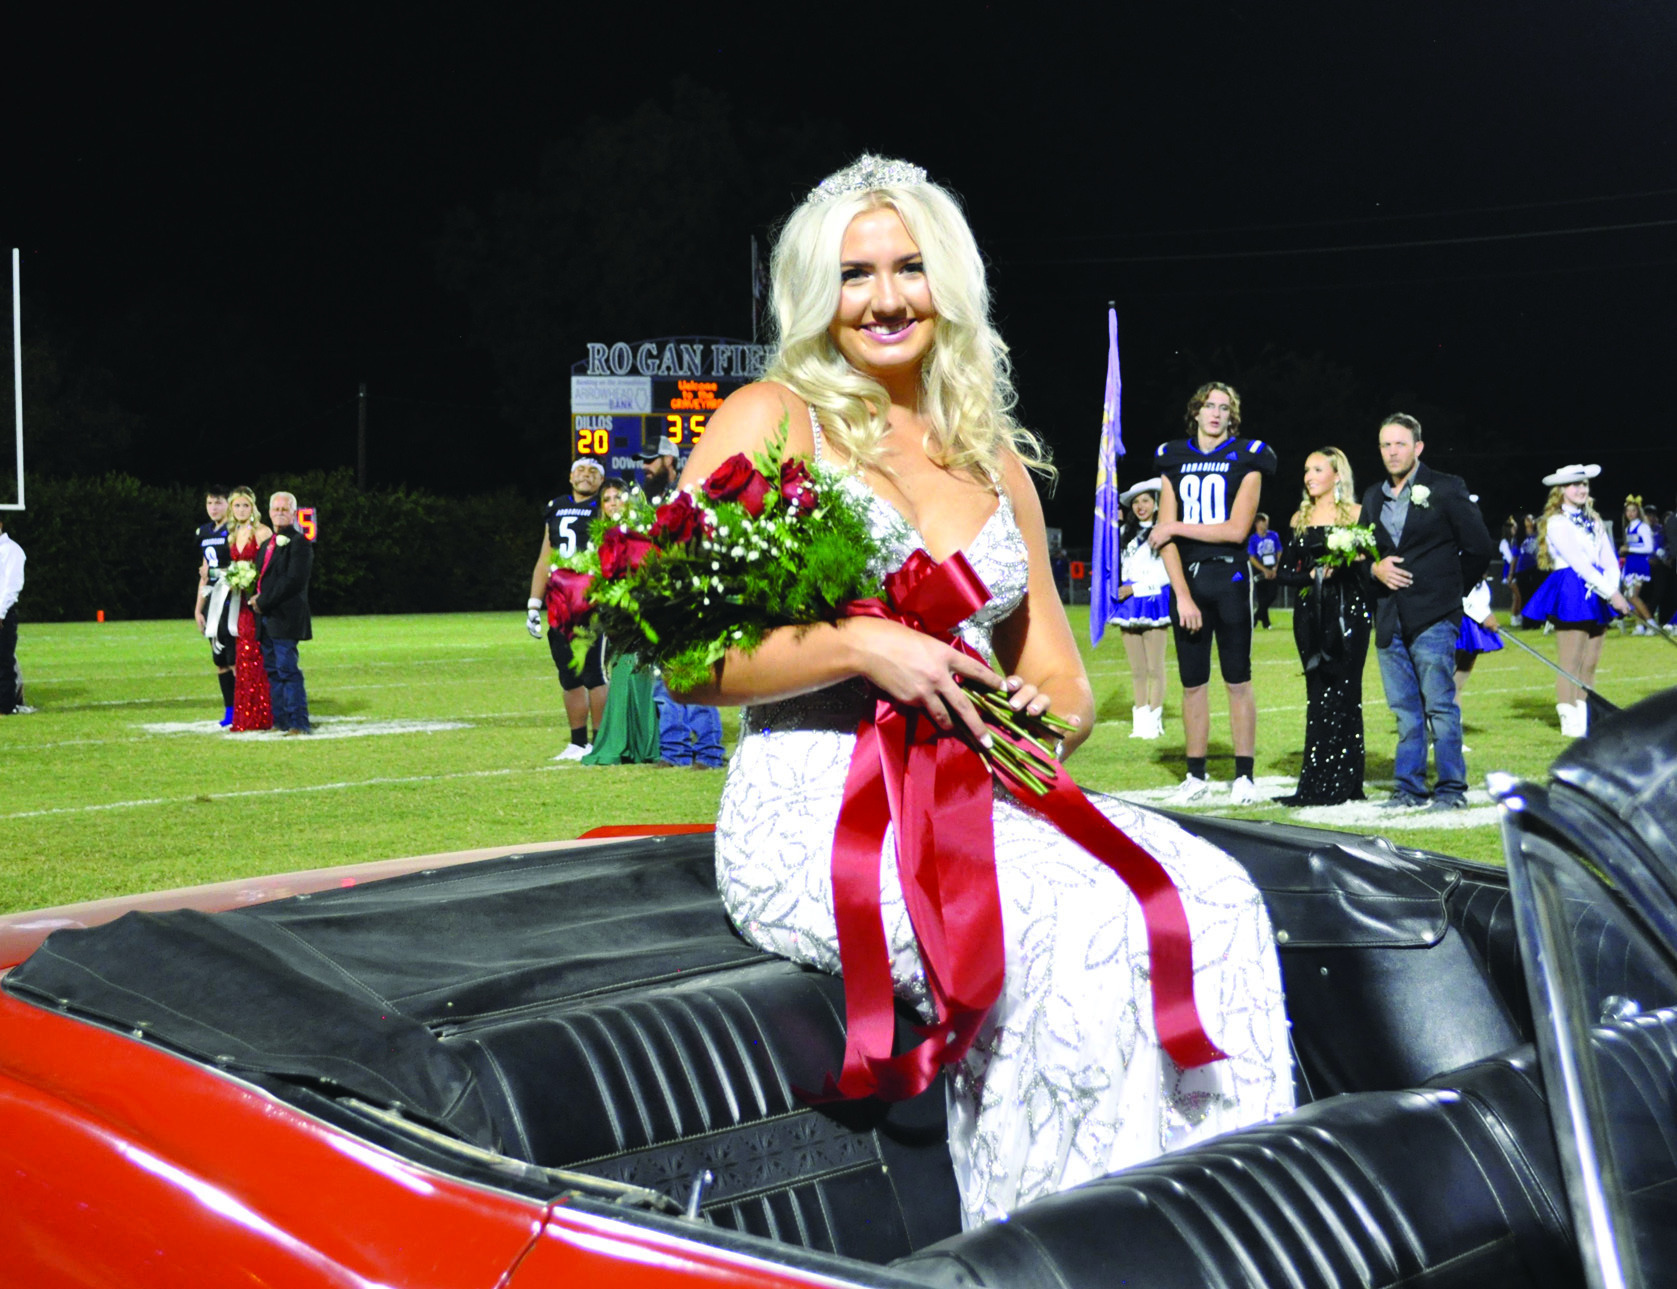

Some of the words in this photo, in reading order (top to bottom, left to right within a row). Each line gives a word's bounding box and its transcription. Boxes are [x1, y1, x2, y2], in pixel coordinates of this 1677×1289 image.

[586, 342, 703, 376] ROGAN
[711, 344, 773, 376] FIE
[609, 399, 633, 409] BANK
[575, 415, 613, 430] DILLOS
[577, 429, 609, 454] 20
[1179, 473, 1226, 525] 80
[297, 507, 316, 541] 5
[558, 516, 578, 558] 5
